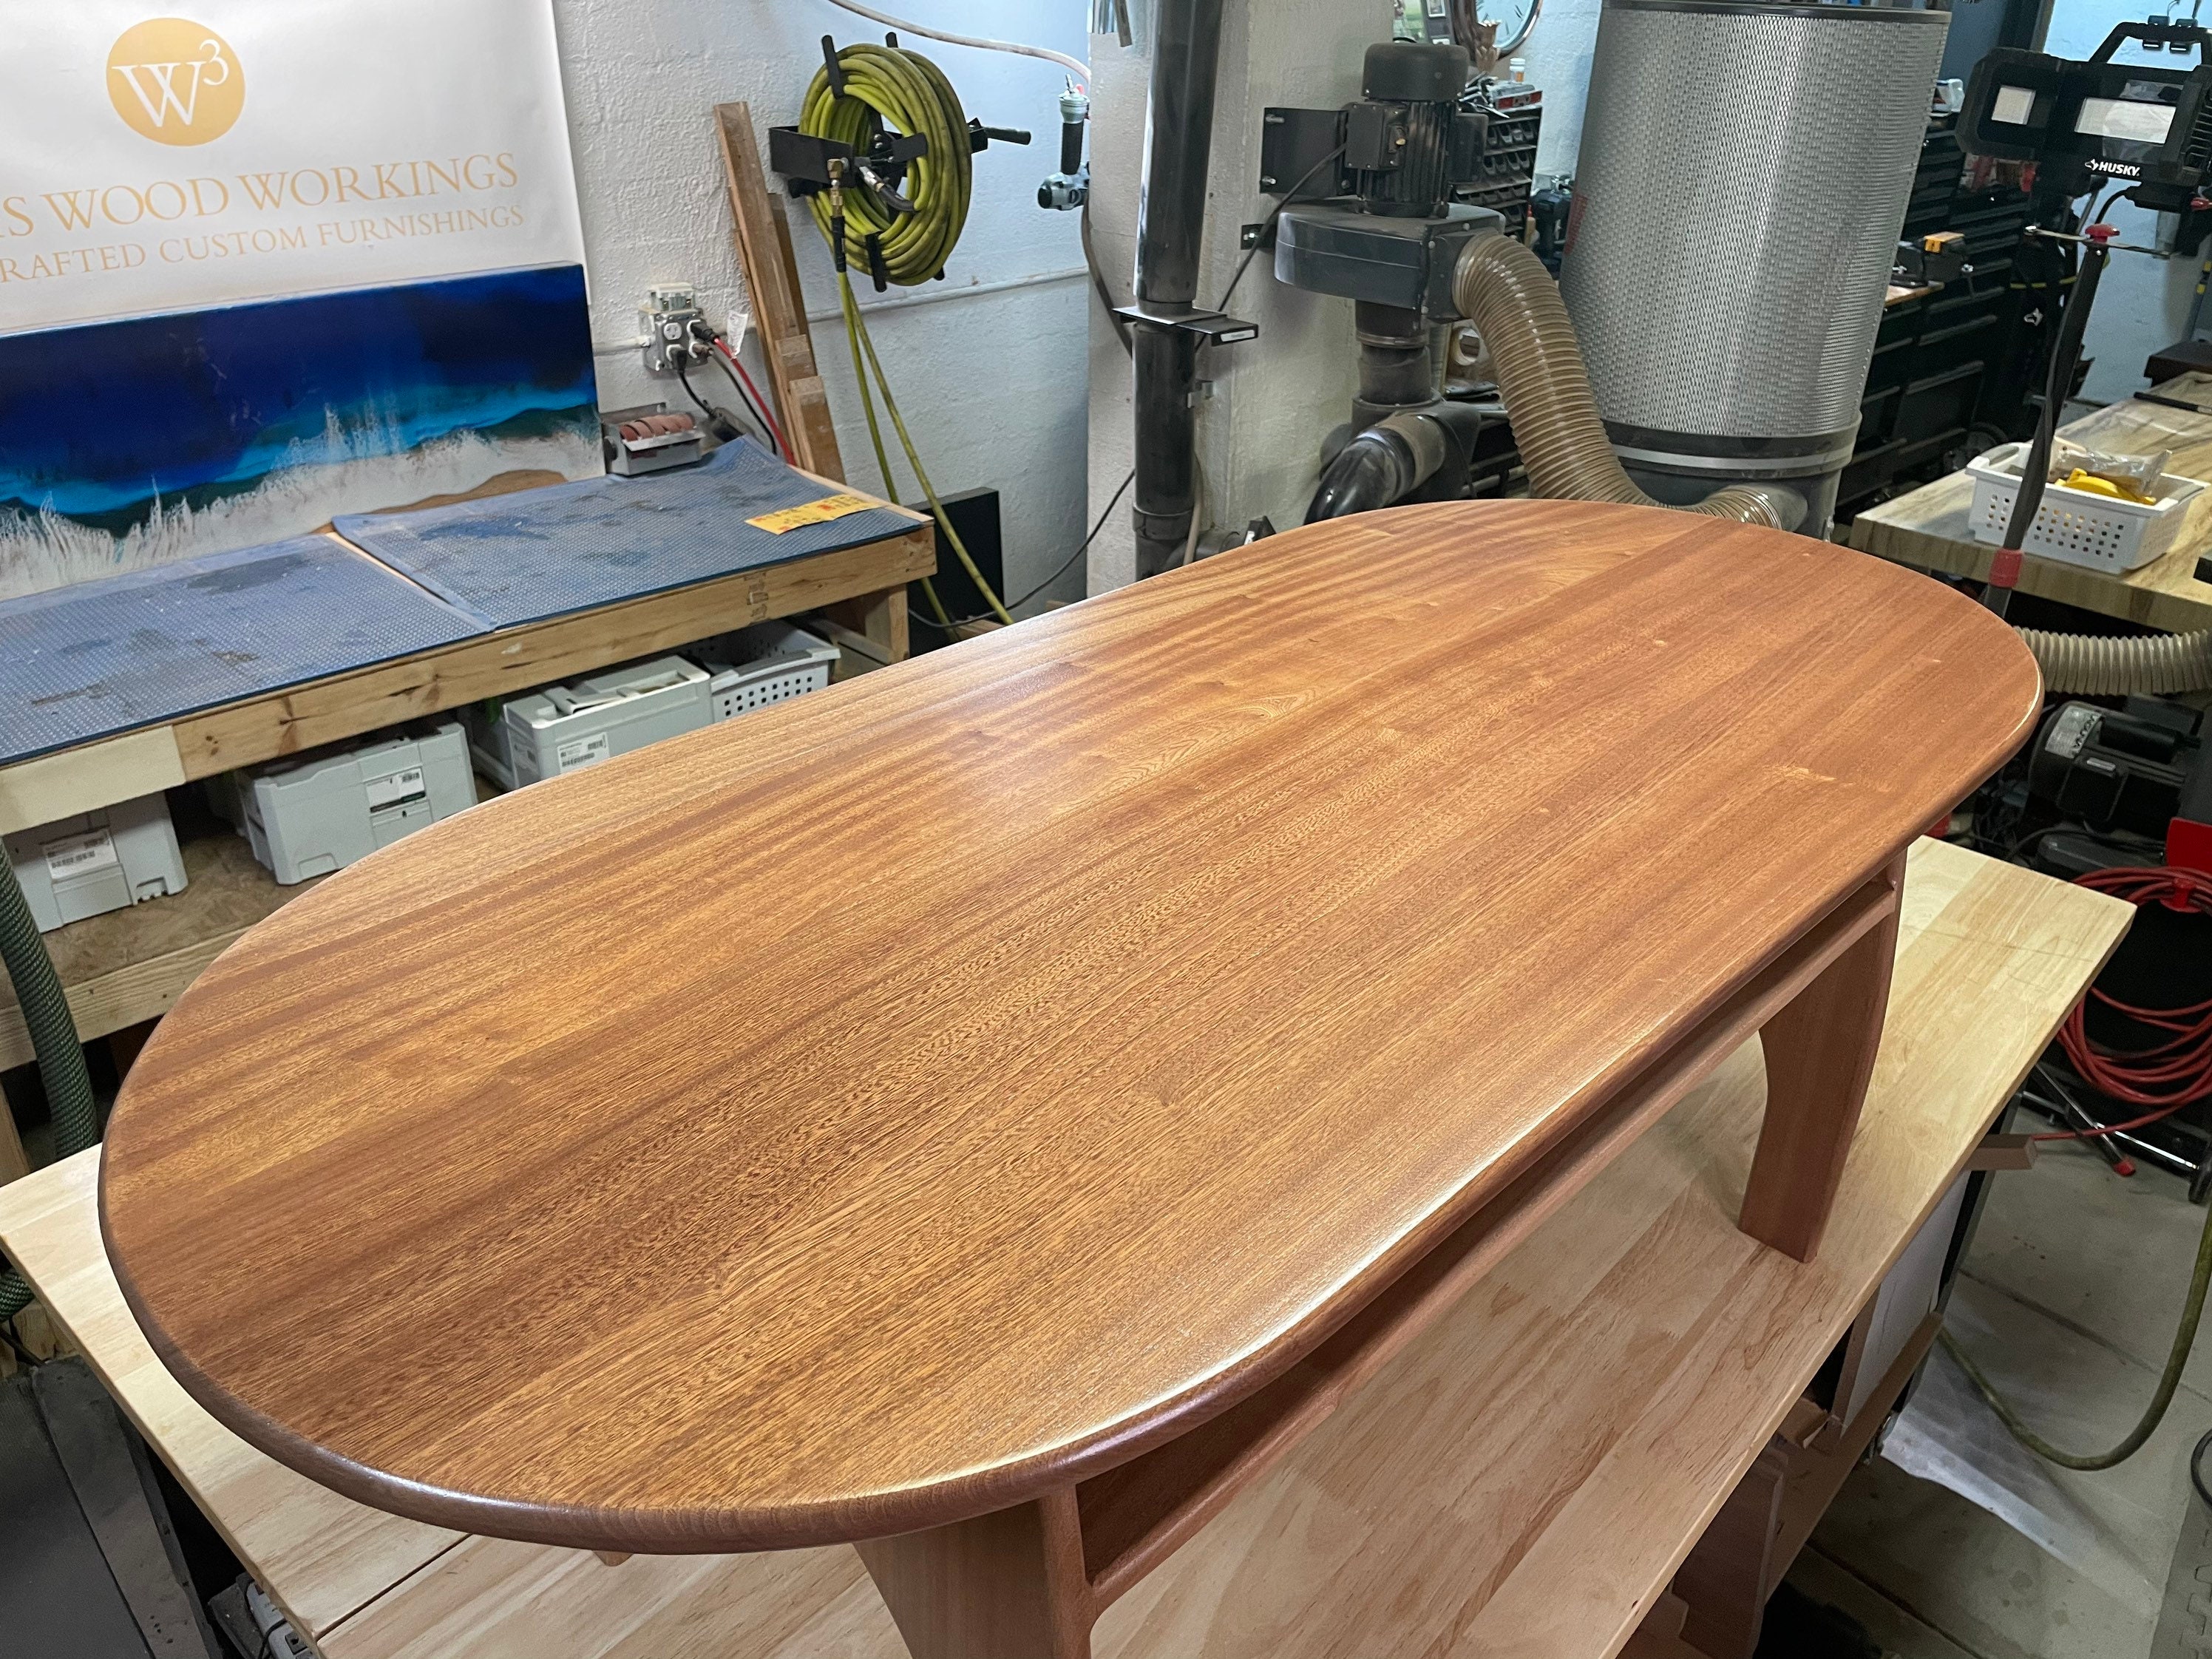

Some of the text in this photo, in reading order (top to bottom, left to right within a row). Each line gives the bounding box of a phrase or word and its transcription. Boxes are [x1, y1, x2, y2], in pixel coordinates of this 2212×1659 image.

[39, 177, 229, 231] WOOD
[235, 152, 518, 211] WORKINGS
[2098, 161, 2140, 176] HUSKY
[159, 225, 307, 263] CUSTOM
[316, 205, 524, 245] FURNISHINGS
